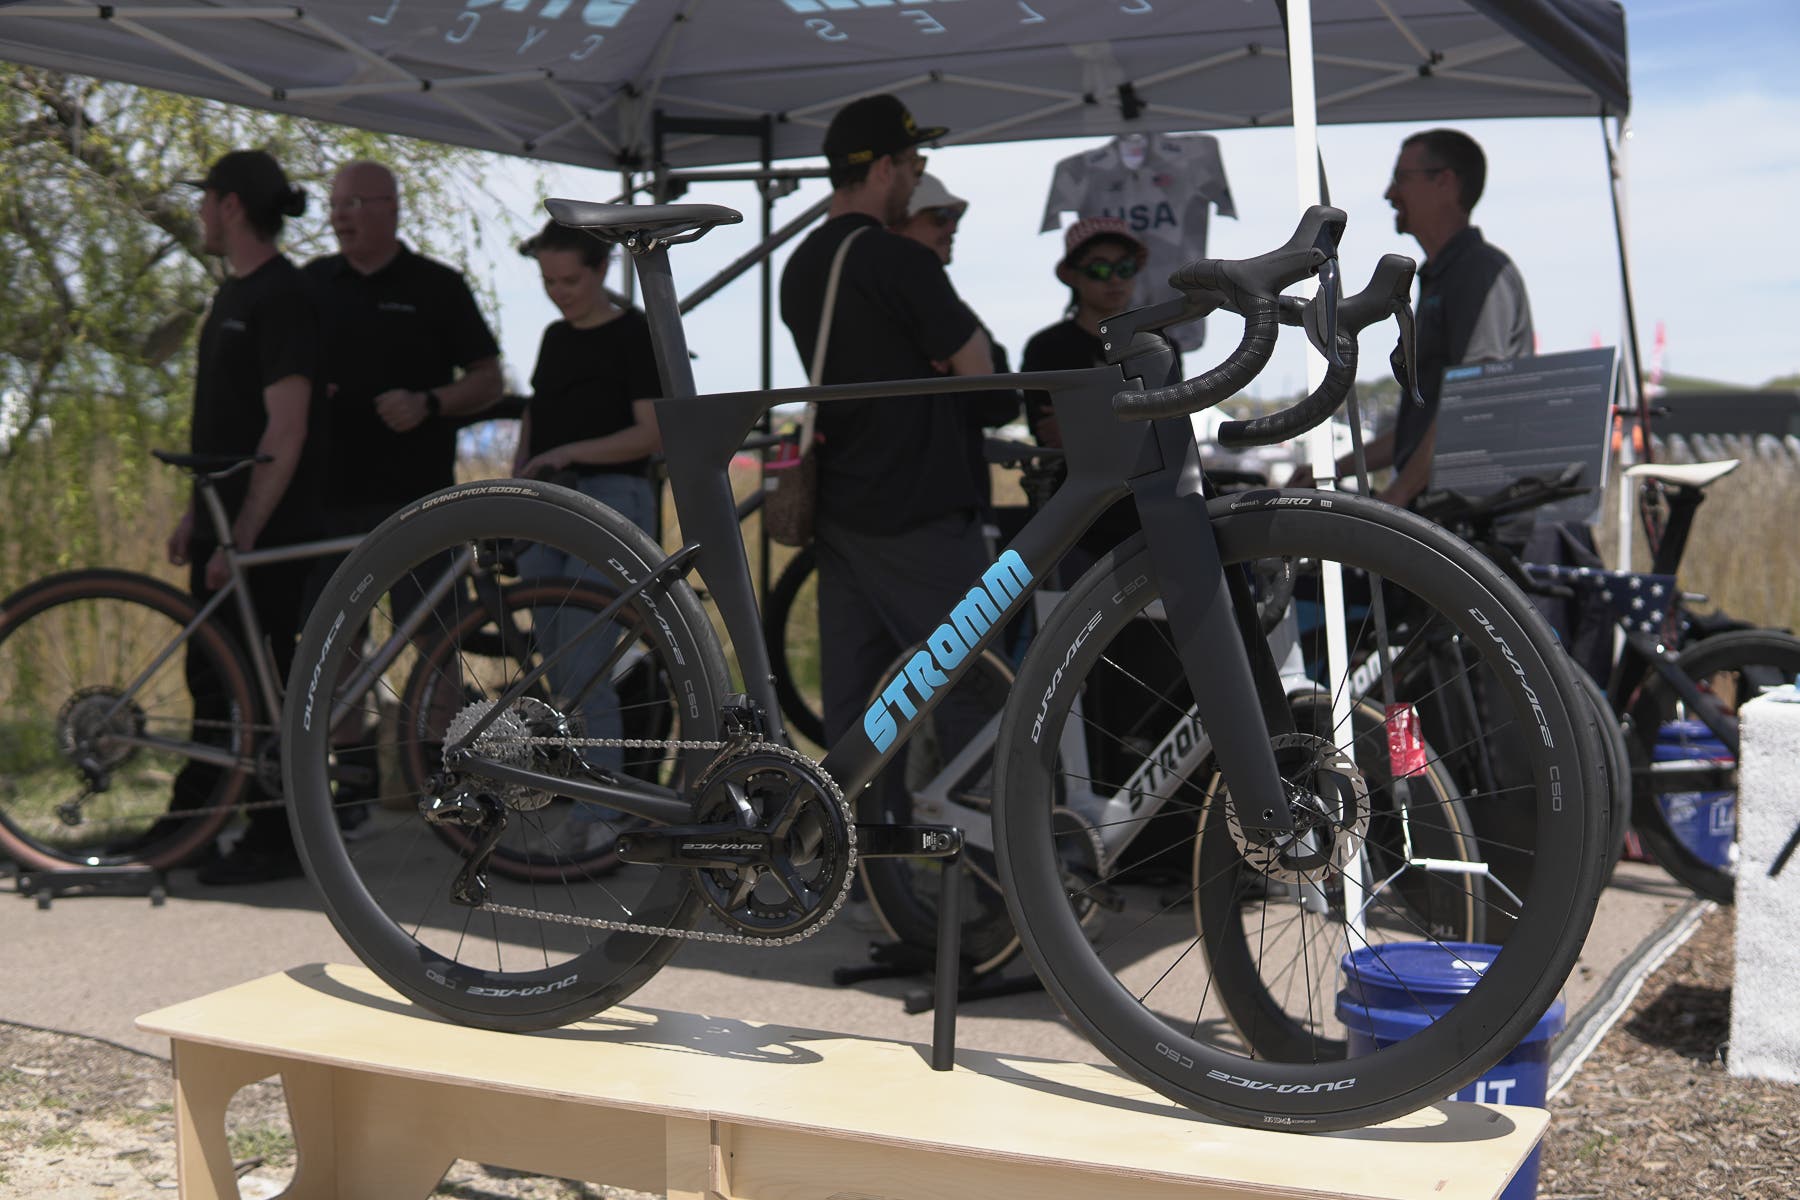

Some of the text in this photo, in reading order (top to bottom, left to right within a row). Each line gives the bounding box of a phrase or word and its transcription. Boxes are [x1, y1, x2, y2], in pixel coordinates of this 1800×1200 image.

[422, 490, 459, 510] GRAND
[459, 486, 488, 498] PRIX
[487, 486, 522, 494] 5000
[1264, 497, 1313, 506] AERO
[607, 557, 686, 666] DUA-ACE
[303, 608, 346, 732] DURA-ACE
[863, 549, 1034, 755] STROMM
[1030, 610, 1103, 745] DURA-ACE
[1468, 607, 1554, 749] DURA-ACE
[1549, 765, 1563, 813] C50
[465, 973, 579, 998] DURA-ACE
[1154, 1041, 1195, 1070] C50
[1205, 1068, 1356, 1094] DURA-ACE
